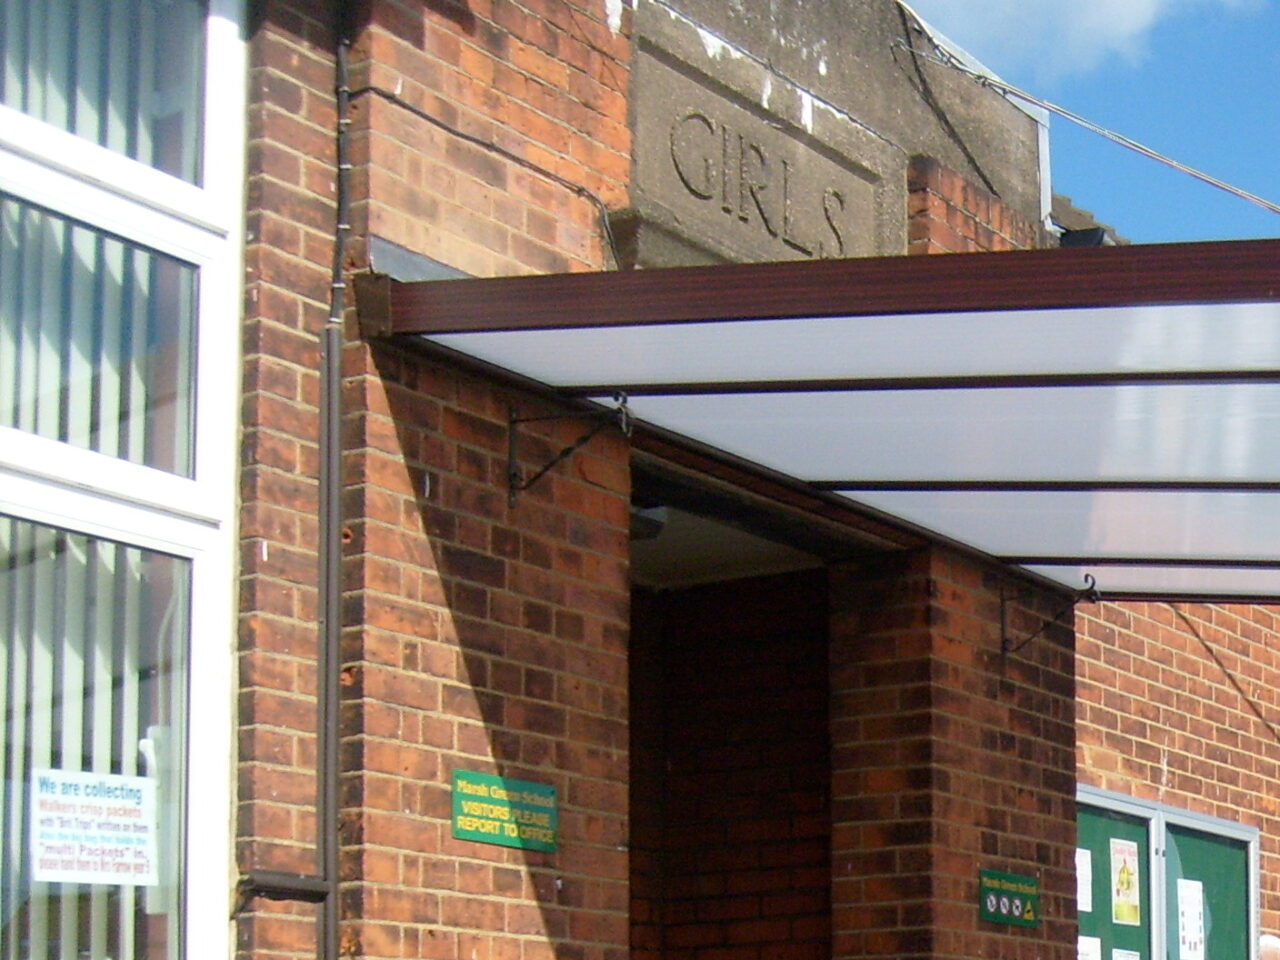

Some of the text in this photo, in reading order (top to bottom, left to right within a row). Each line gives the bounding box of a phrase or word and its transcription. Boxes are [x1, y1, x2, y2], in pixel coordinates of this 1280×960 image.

[669, 112, 845, 258] GIRLS
[39, 776, 142, 805] We are collecting
[457, 815, 555, 843] REPORT TO OFFICE
